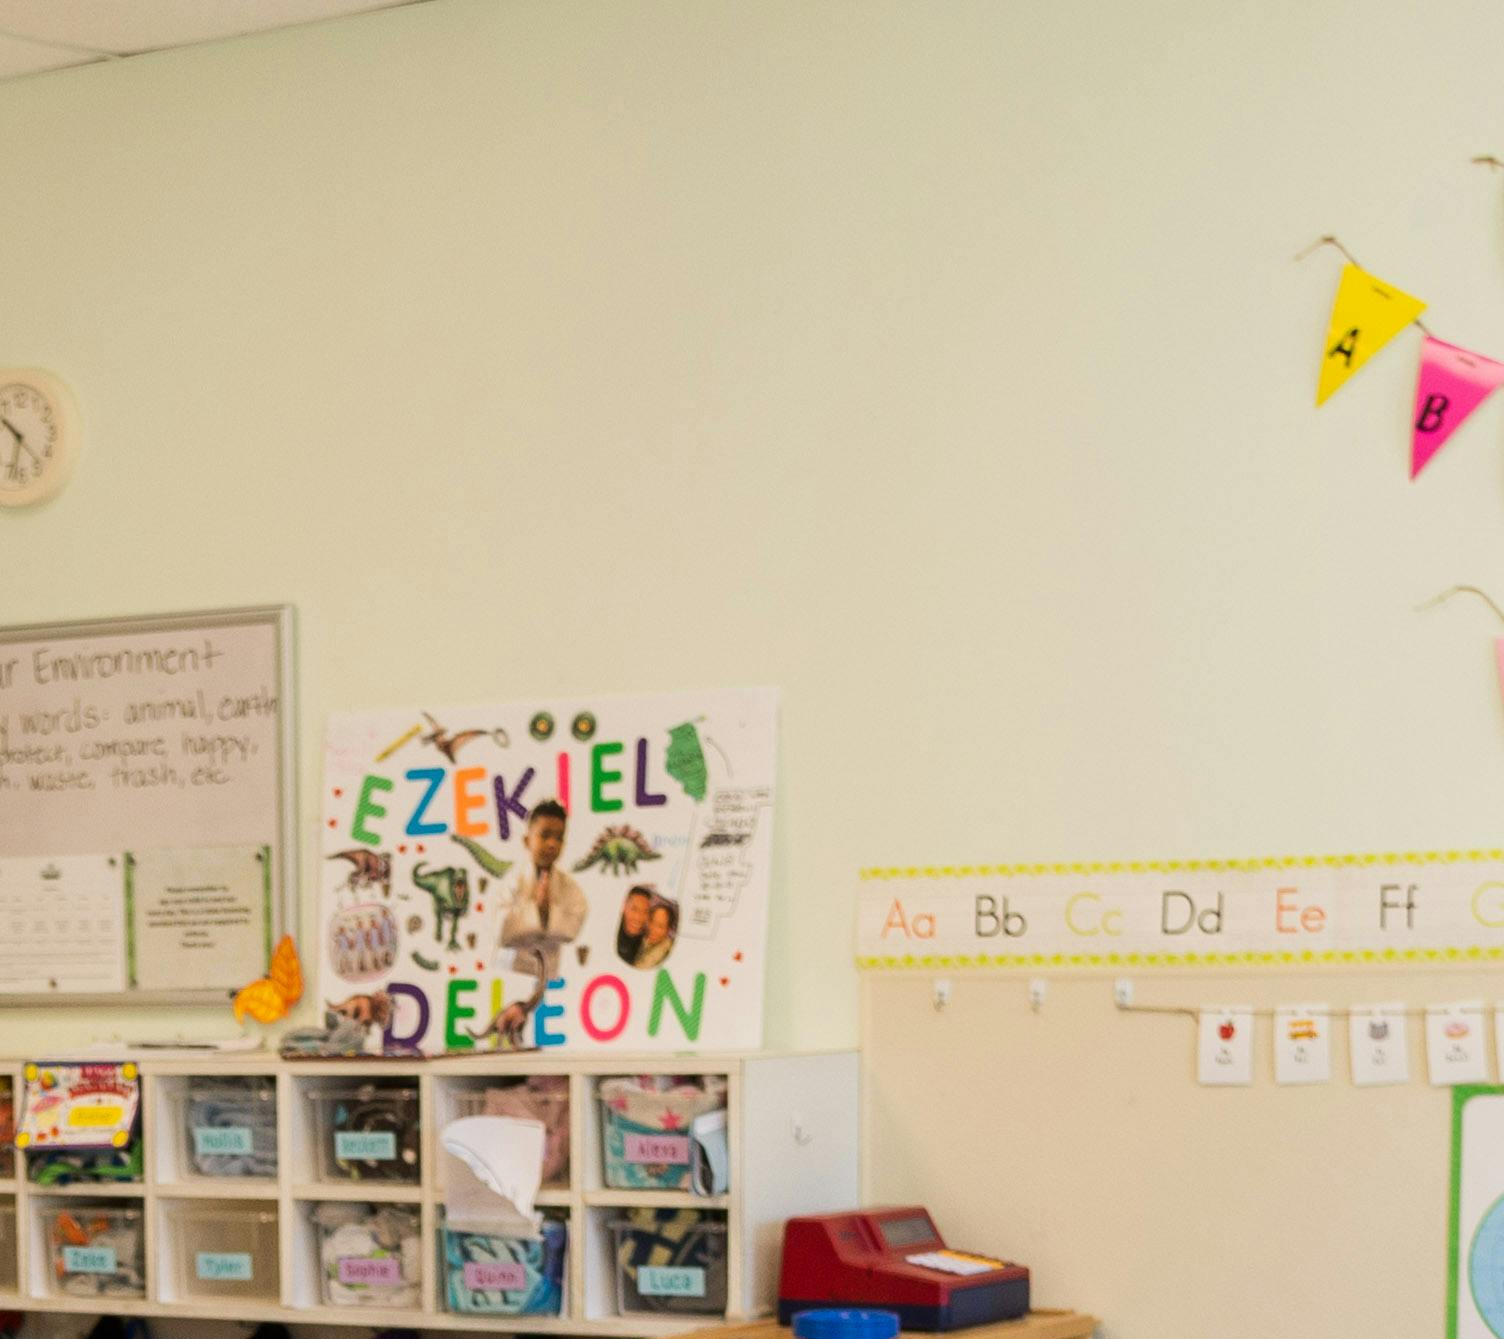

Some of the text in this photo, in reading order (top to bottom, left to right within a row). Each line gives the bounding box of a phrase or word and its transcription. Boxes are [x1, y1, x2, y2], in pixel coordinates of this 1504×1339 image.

[33, 639, 224, 685] Environment
[351, 737, 669, 845] EZEKIEL
[880, 898, 937, 942] Aa
[973, 894, 1028, 939] Bb
[1063, 891, 1124, 938] Cc
[1160, 888, 1225, 937] Dd
[1273, 886, 1328, 936] Ee
[1378, 883, 1420, 933] Ff
[650, 1271, 691, 1288] Luca
